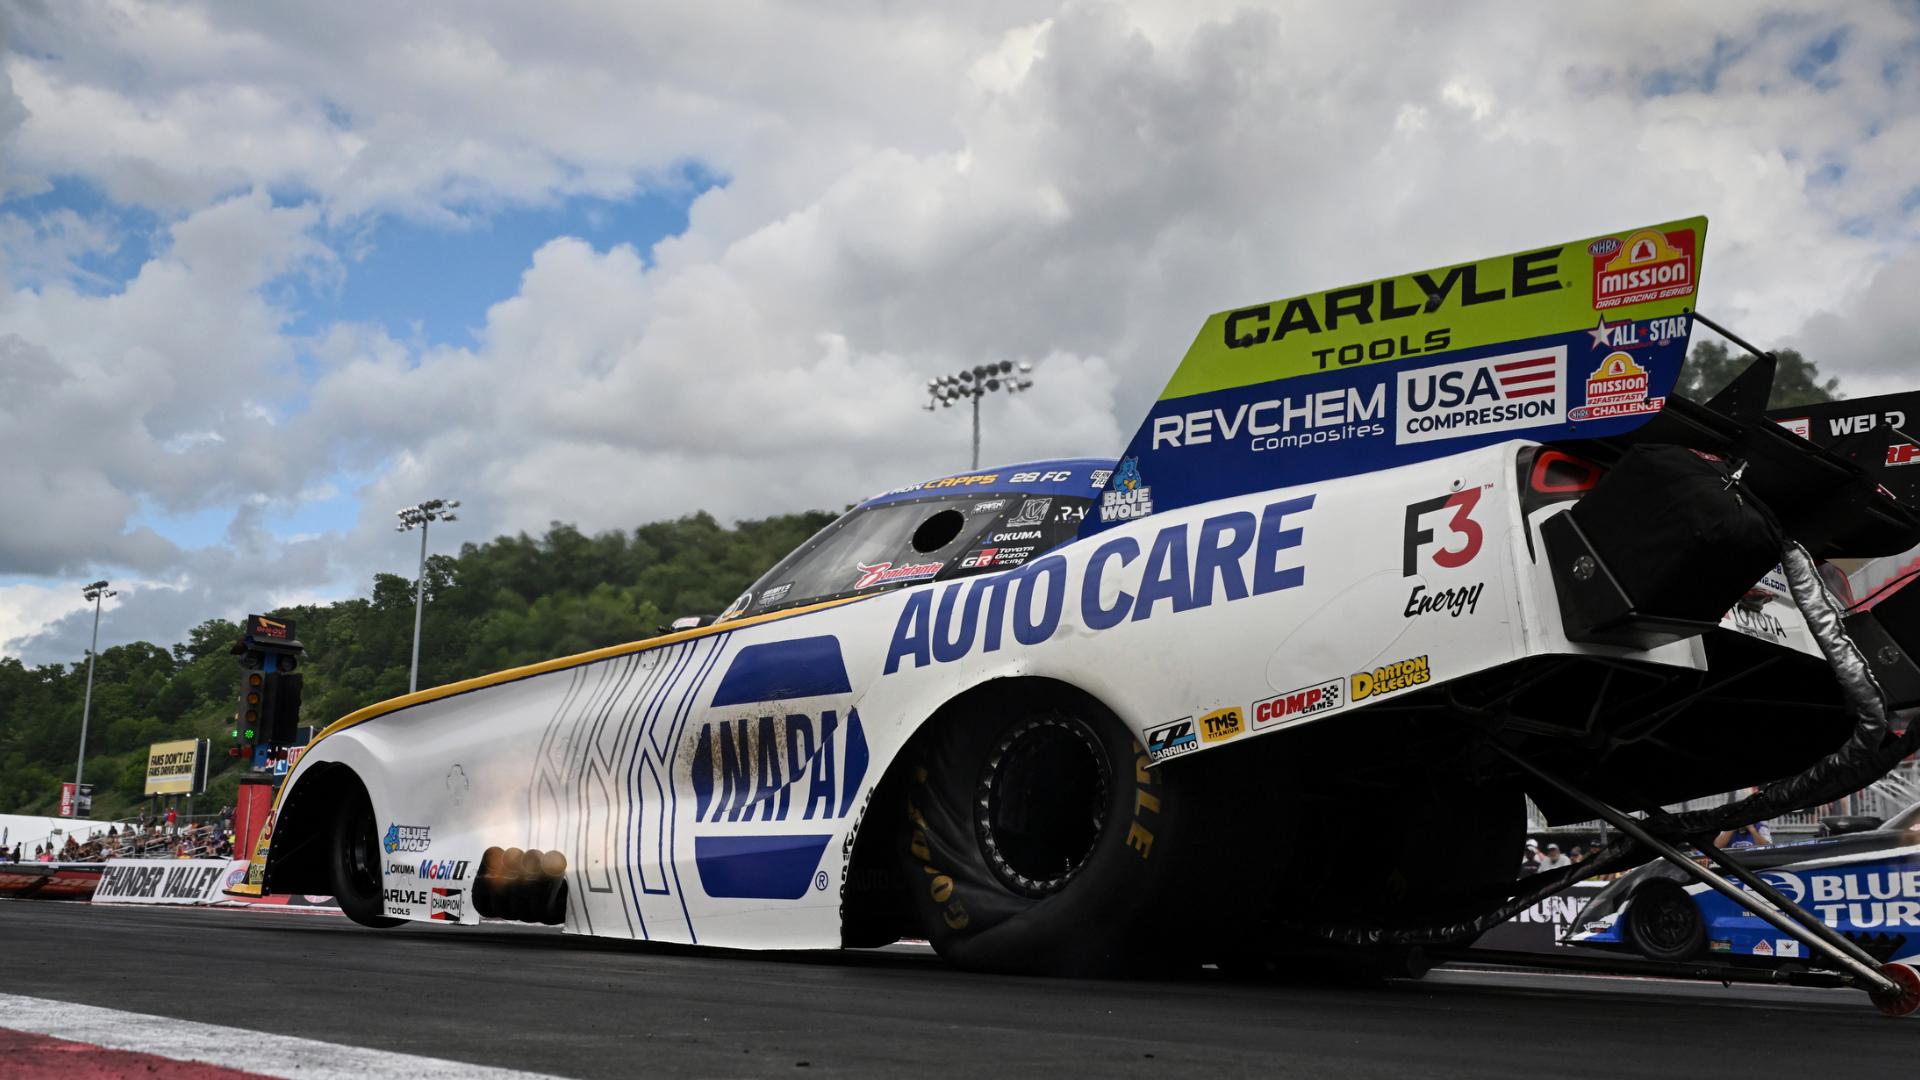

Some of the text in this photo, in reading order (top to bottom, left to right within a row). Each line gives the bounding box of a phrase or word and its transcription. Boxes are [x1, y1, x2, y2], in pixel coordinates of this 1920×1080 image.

[1591, 239, 1619, 254] NHRA
[1224, 247, 1564, 349] CARLYLE
[1595, 285, 1694, 310] DRAG RACING SERIES
[1612, 316, 1687, 347] ALL STAR
[1312, 328, 1451, 369] TOOLS
[1407, 366, 1501, 413] USA
[1153, 383, 1386, 450] REVCHEM
[1406, 399, 1556, 434] COMPRESSION
[1592, 400, 1661, 417] CHALLENGE
[1251, 422, 1385, 452] Composites
[923, 474, 999, 489] CAPPS
[1009, 472, 1036, 483] 28
[1039, 471, 1072, 482] FC
[1103, 488, 1150, 506] BLUE
[1101, 502, 1152, 521] WOLF
[993, 530, 1043, 542] OKUMA
[1403, 486, 1483, 577] F3
[995, 552, 1029, 560] GAZOO
[998, 546, 1035, 554] TOYOTA
[962, 554, 993, 568] GR
[882, 494, 1317, 675] AUTO CARE
[1403, 582, 1485, 618] Energy
[1351, 655, 1428, 702] DARTON
[1372, 669, 1431, 696] SLEEVES
[1256, 688, 1322, 723] COMP
[1301, 699, 1334, 715] CAMS
[1204, 711, 1239, 734] TMS
[1208, 726, 1240, 740] TITANIUM
[150, 751, 195, 766] FANS DON'T LET
[1151, 740, 1198, 761] CARRILLO
[160, 765, 175, 776] DRIVE
[710, 710, 839, 823] NAPA
[398, 825, 431, 840] BLUE
[398, 838, 431, 853] WOLF
[390, 863, 415, 876] OKUMA
[418, 859, 455, 880] Mobil
[97, 865, 166, 898] THUNDER
[161, 866, 225, 899] VALLEY
[384, 888, 428, 905] ARLYLE
[432, 898, 461, 912] CHAMPION
[388, 906, 411, 916] TOOLS
